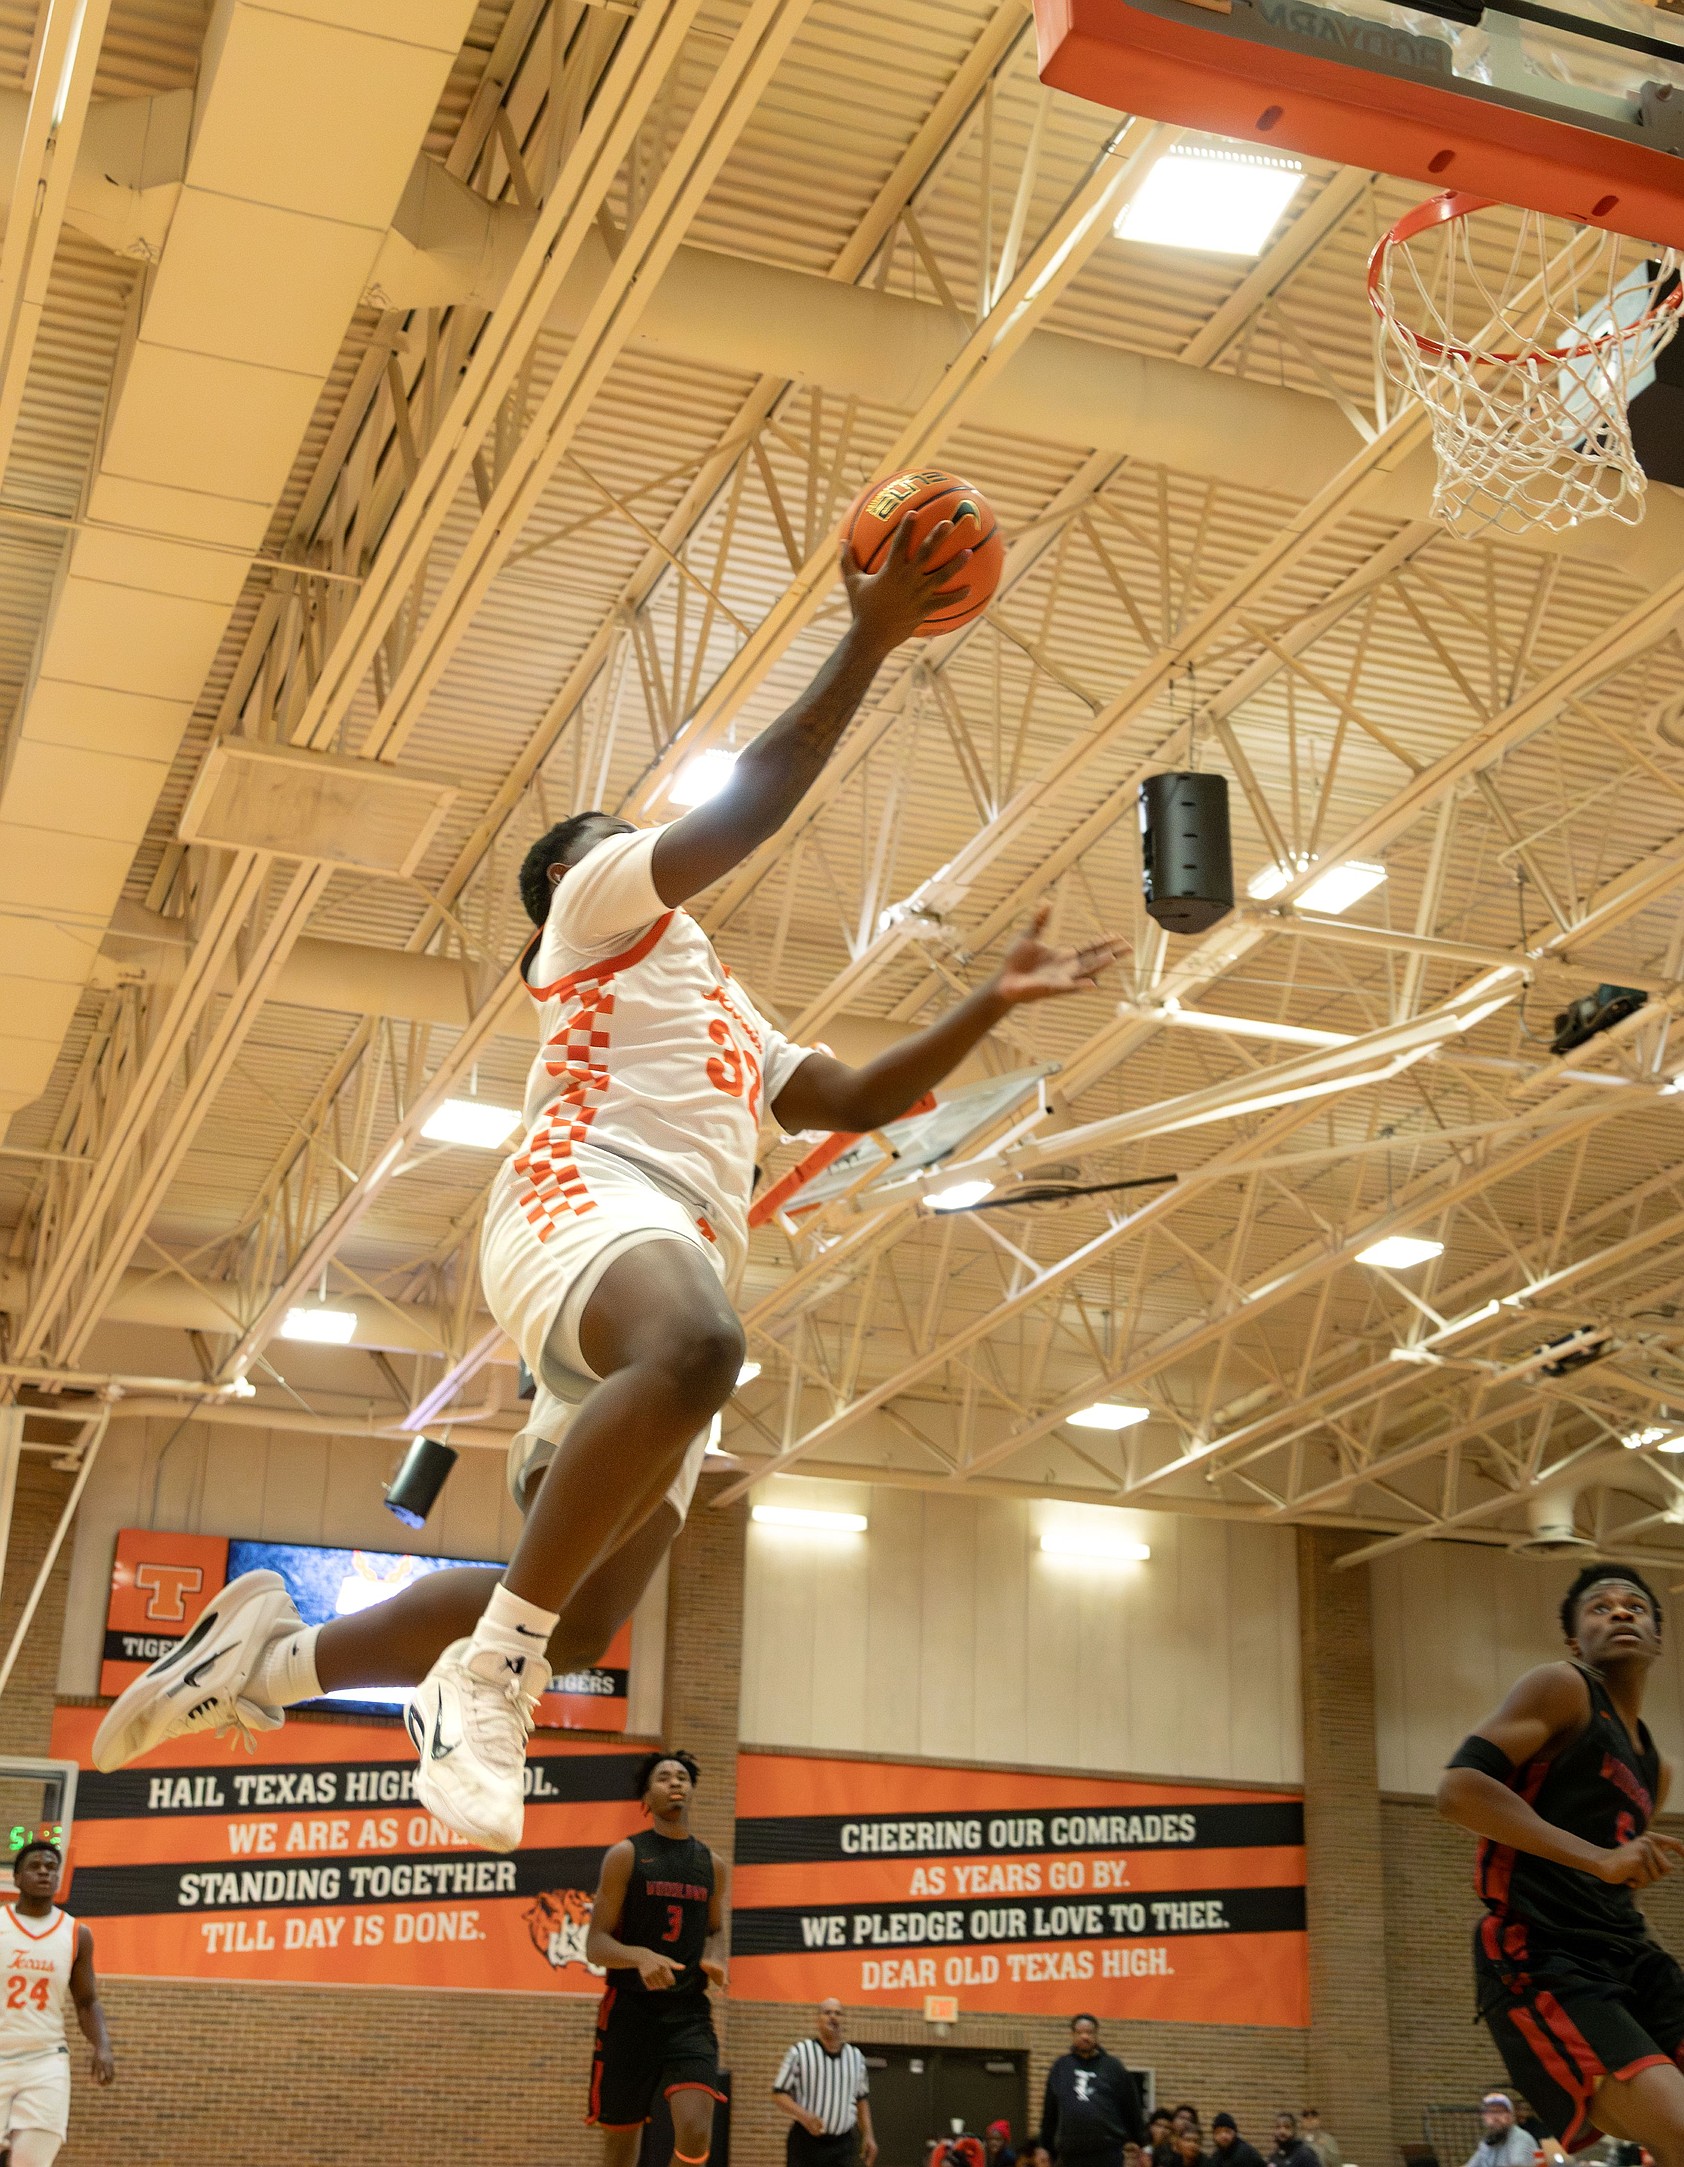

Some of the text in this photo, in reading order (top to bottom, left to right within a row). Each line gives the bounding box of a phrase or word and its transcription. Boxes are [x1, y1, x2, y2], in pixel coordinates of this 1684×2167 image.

[136, 1562, 204, 1621] T
[148, 1776, 225, 1809] HAIL
[233, 1772, 337, 1806] TEXAS
[228, 1822, 278, 1855] WE
[285, 1818, 350, 1852] ARE
[357, 1817, 398, 1850] AS
[841, 1813, 1196, 1854] CHEERING OUR COMRADES
[178, 1860, 517, 1906] STANDING TOGETHER
[909, 1859, 1131, 1896] AS YEARS GO BY.
[201, 1910, 487, 1954] TILL DAY IS DONE.
[662, 1904, 683, 1943] 3
[801, 1900, 1230, 1947] WE PLEDGE OUR LOVE TO THEE.
[861, 1947, 1175, 1991] DEAR OLD TEXAS HIGH.
[6, 1974, 49, 2012] 24
